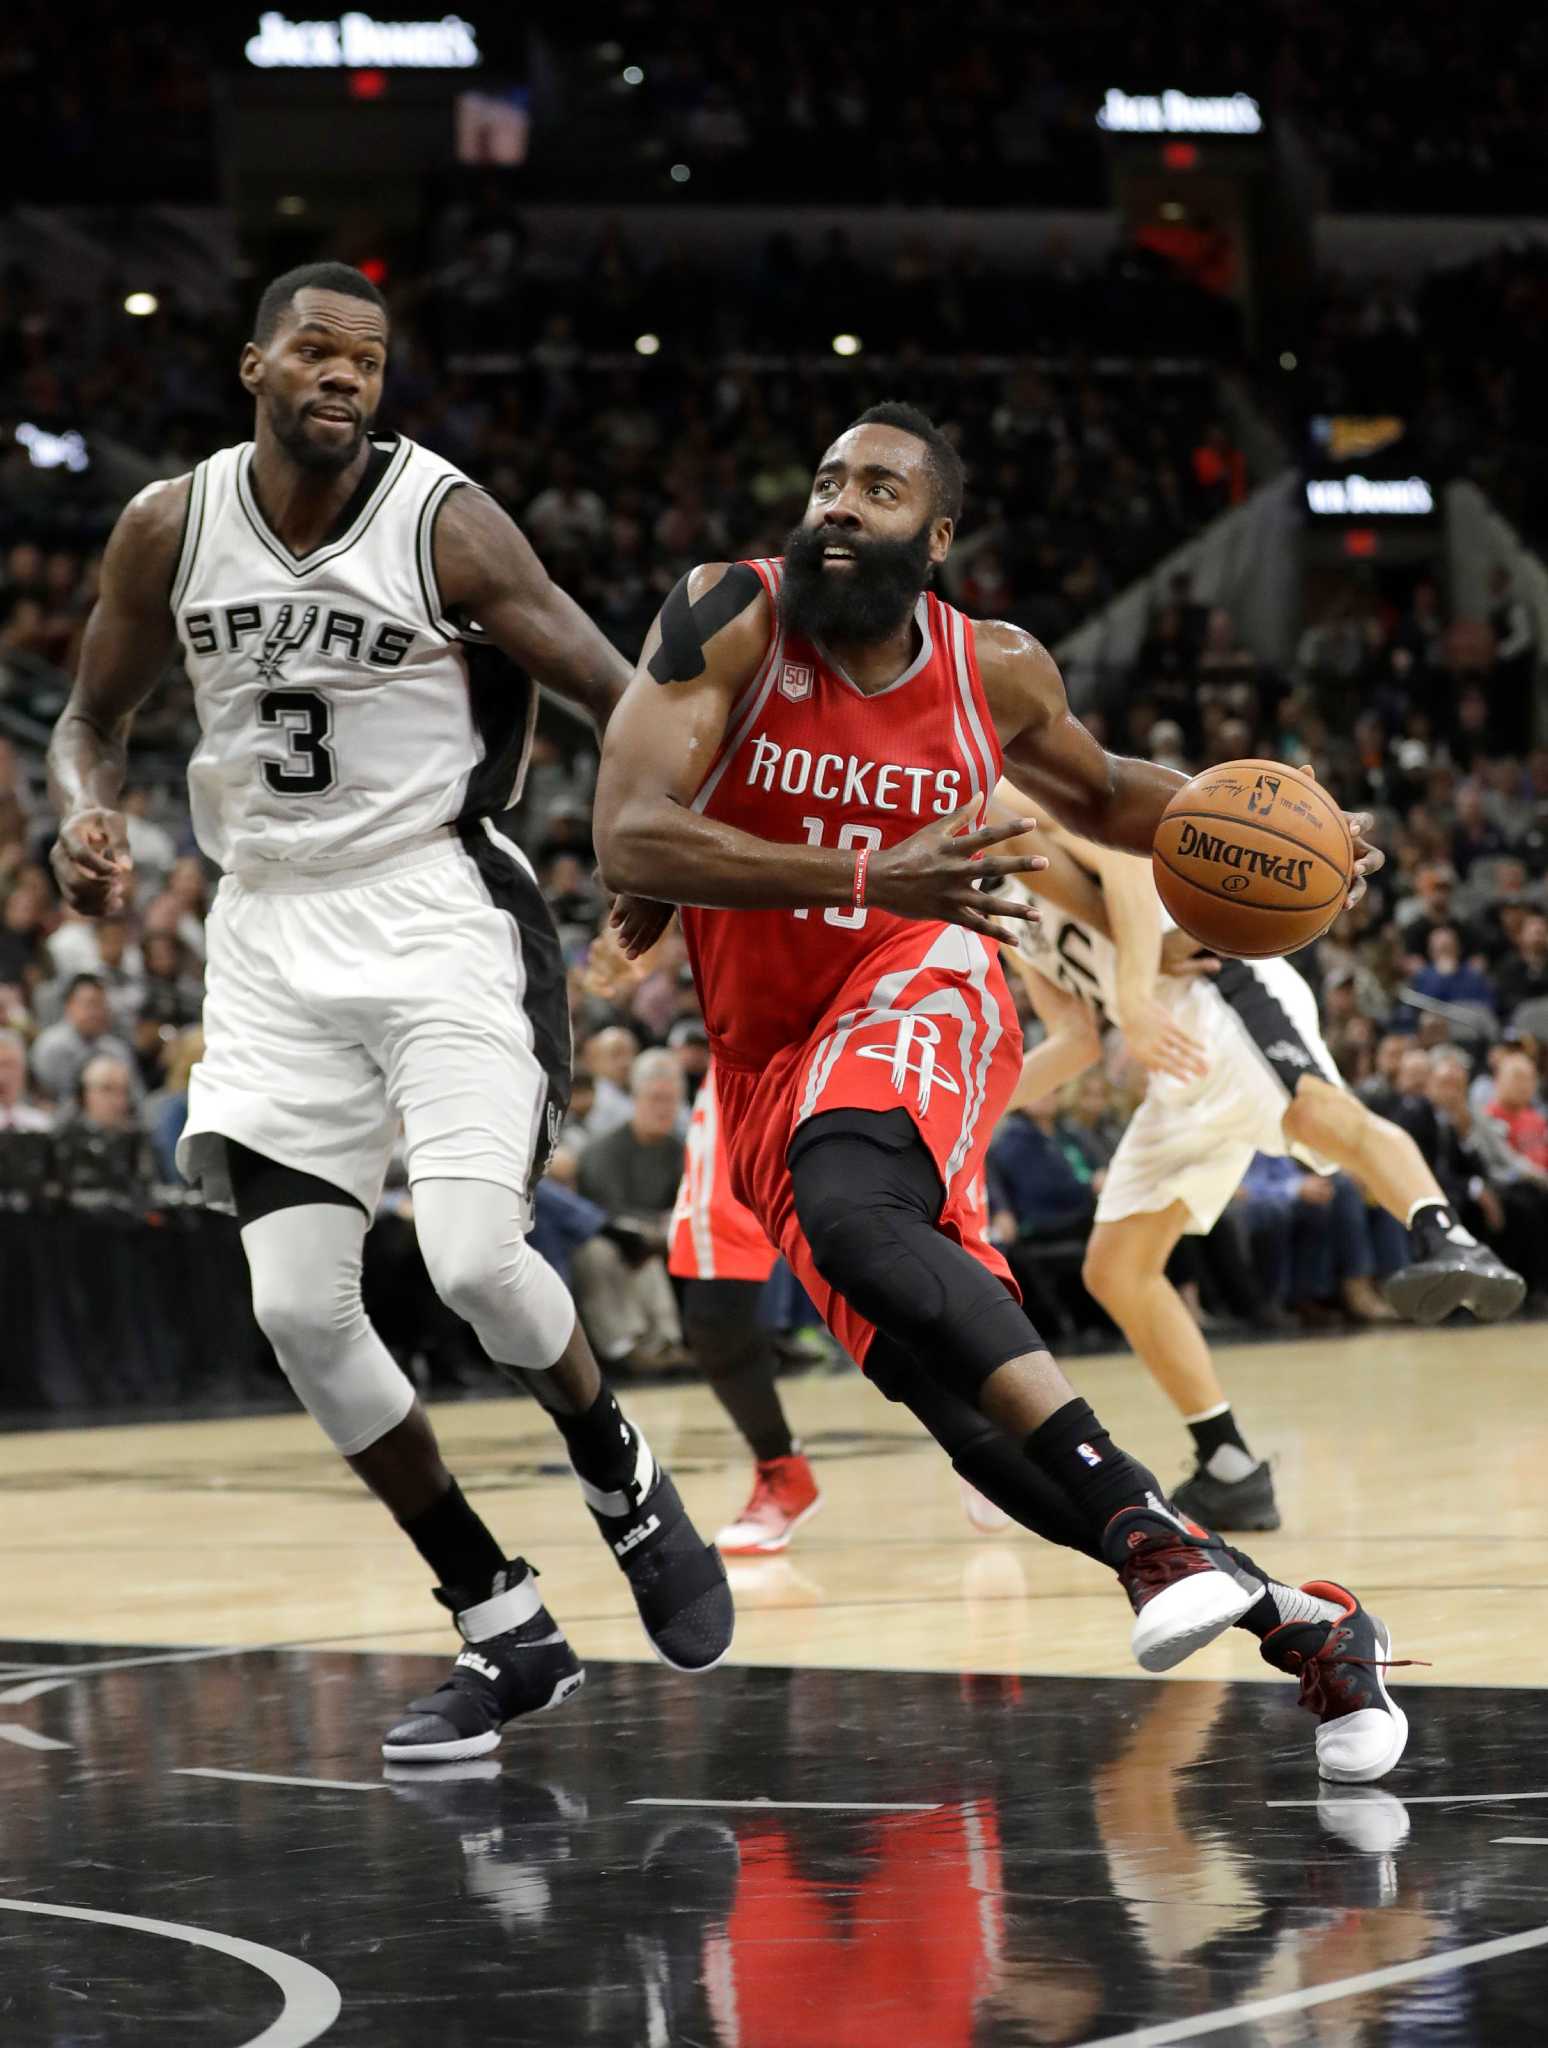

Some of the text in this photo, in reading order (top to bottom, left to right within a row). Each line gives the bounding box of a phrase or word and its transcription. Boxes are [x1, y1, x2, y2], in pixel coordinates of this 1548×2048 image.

[185, 604, 416, 670] SPURS
[785, 666, 807, 686] 50
[257, 687, 338, 797] 3
[746, 732, 960, 816] ROCKETS
[1177, 823, 1313, 891] SPALDING
